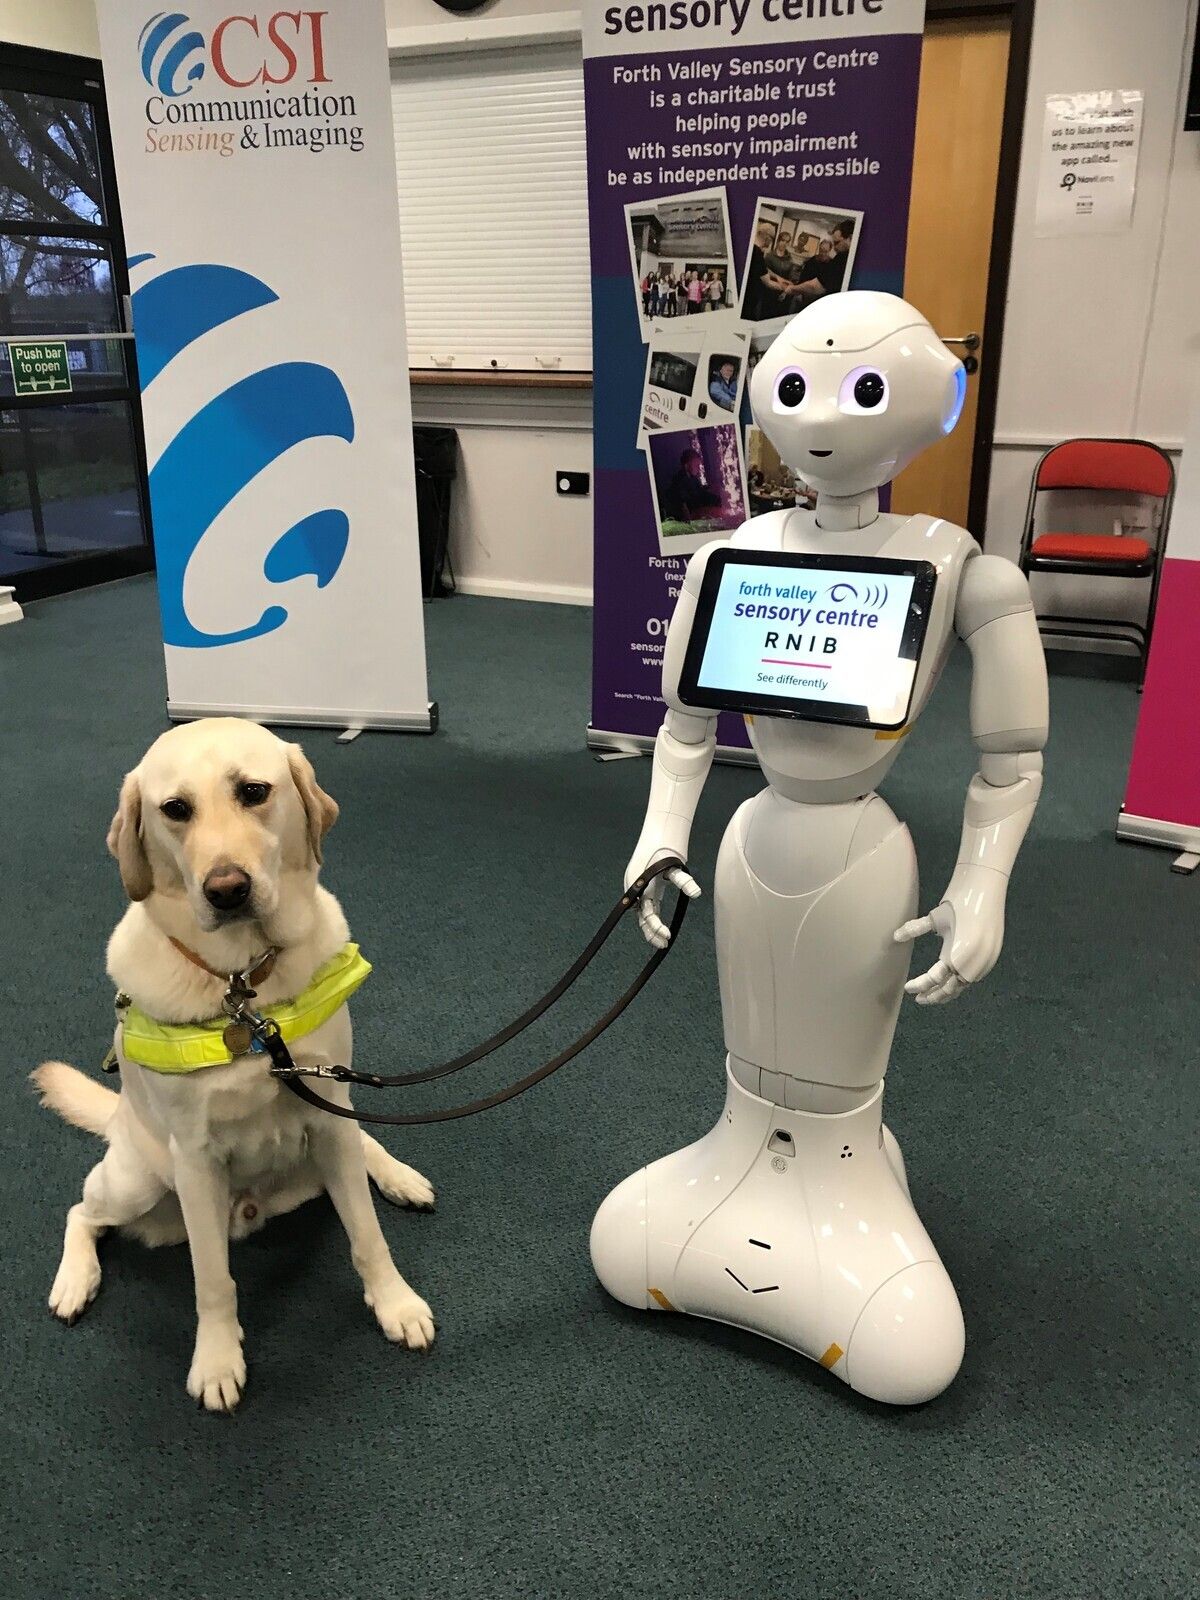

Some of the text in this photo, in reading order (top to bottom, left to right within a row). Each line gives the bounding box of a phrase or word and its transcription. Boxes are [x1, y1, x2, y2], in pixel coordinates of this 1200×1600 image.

[604, 0, 750, 36] sensory
[211, 10, 333, 88] CSI
[613, 48, 879, 84] Forth Valley Sensory Centre
[650, 78, 836, 108] is a charitable trust
[146, 87, 357, 125] Communication
[676, 107, 808, 134] helping people
[1065, 127, 1075, 136] to
[1077, 125, 1103, 135] learn
[1104, 123, 1134, 134] about
[145, 119, 365, 157] Sensing & Imaging
[627, 131, 858, 160] with sensory impairment
[1052, 139, 1134, 152] the amazing new
[607, 157, 880, 186] be as independent as possible
[1061, 157, 1079, 167] app
[15, 346, 62, 360] Push bar
[21, 361, 61, 374] to open
[645, 404, 670, 424] centre
[648, 556, 680, 569] Forth
[664, 571, 686, 581] (nex
[738, 581, 818, 604] forth valley
[733, 601, 879, 629] sensory centre
[764, 631, 838, 654] RNIB
[756, 672, 829, 691] See differently
